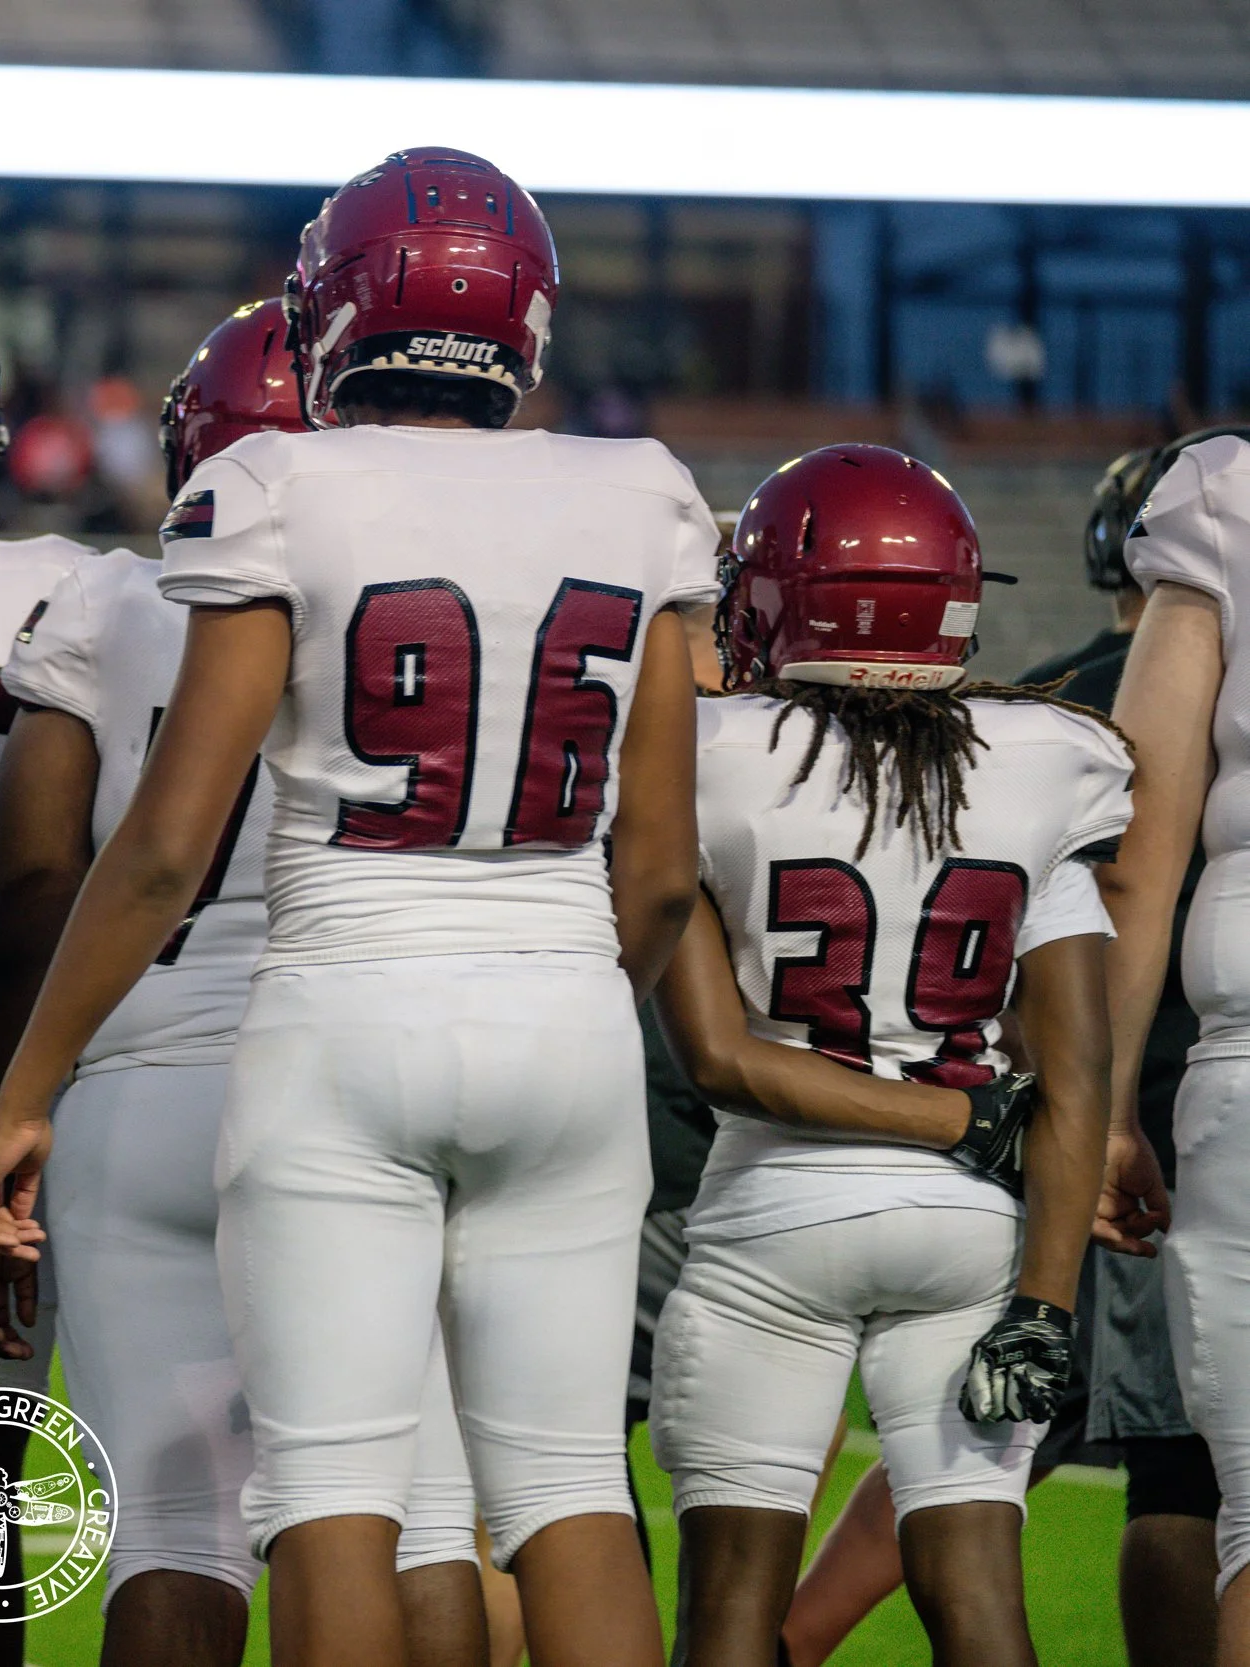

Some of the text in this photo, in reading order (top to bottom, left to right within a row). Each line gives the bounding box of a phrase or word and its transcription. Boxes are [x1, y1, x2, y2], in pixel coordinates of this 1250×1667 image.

[406, 333, 501, 365] schutt
[849, 666, 944, 690] Riddell
[328, 576, 644, 851] 96
